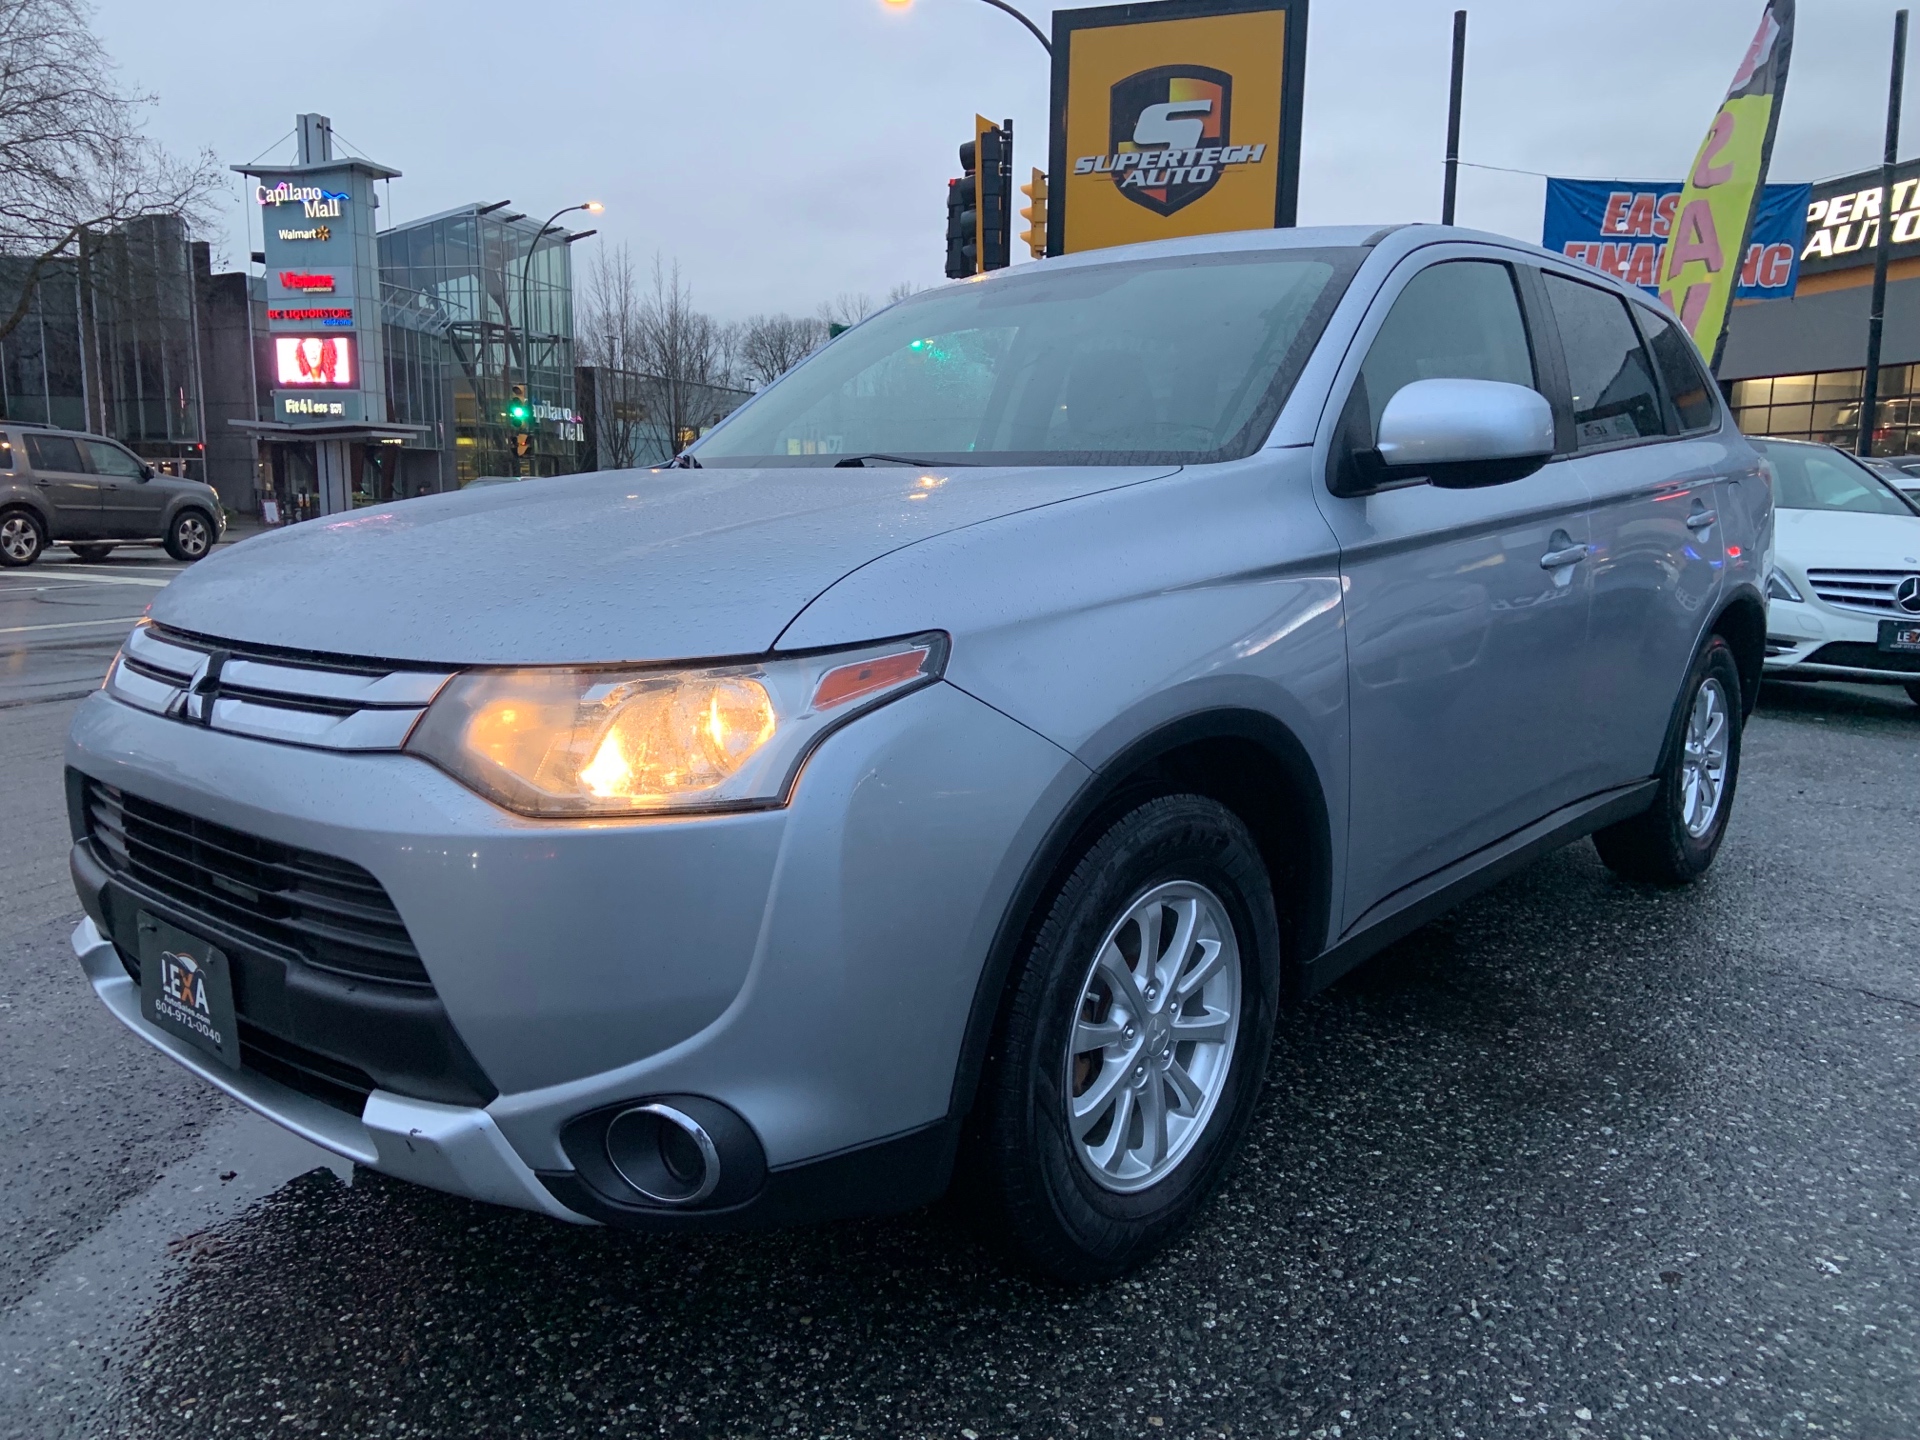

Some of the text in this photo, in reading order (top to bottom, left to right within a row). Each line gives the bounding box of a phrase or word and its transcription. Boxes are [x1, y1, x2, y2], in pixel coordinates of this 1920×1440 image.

[1073, 143, 1267, 175] SUPERTECH
[1121, 165, 1214, 188] AUTO
[256, 182, 321, 206] Capilano
[1806, 179, 1920, 228] PERT
[304, 199, 339, 218] Mall
[1600, 191, 1682, 237] EAS
[278, 229, 316, 239] Walmart
[279, 271, 334, 288] Visions
[161, 958, 210, 1015] LEXA
[155, 999, 222, 1044] 604-971-0040
